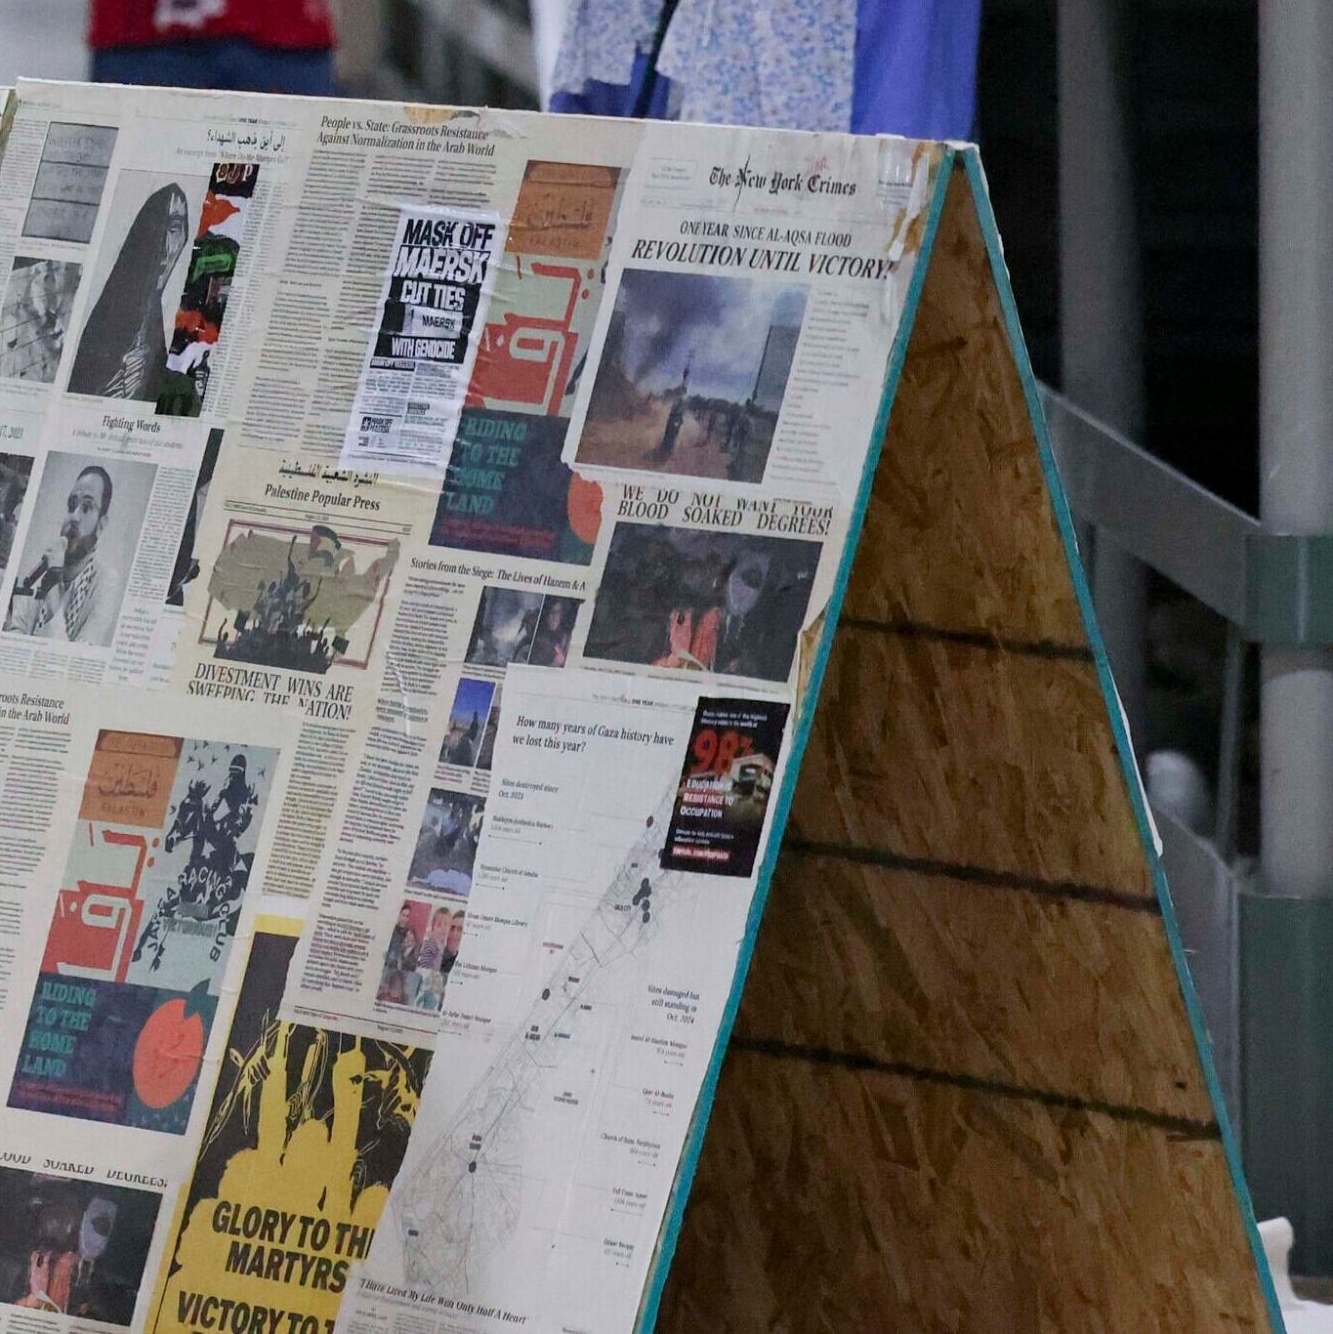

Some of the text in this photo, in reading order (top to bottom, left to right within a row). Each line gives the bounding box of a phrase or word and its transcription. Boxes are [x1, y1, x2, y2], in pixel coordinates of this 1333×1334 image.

[320, 116, 490, 140] People vs. State: Grassroots Resistance
[317, 132, 495, 157] Against Normalization in the Arab World
[709, 166, 733, 187] The
[735, 167, 766, 189] New
[769, 171, 803, 195] York
[807, 174, 857, 196] Crimes
[403, 219, 495, 249] MASK OFF
[680, 220, 852, 248] ONE YEAR SINCE AL-AQSA FLOOD
[393, 246, 491, 284] MAERSK
[632, 239, 895, 280] REVOLUTION UNTIL VICTORY!
[400, 280, 466, 311] CUT TIES
[392, 337, 455, 360] WITH GENOCIDE
[102, 415, 161, 433] Fighting Words
[265, 483, 381, 511] Palestine Popular Press
[622, 484, 644, 501] WE
[657, 489, 680, 504] DO
[691, 493, 722, 508] NOT
[617, 500, 831, 536] BLOOD SOAKED DEGREES!
[410, 557, 437, 571] Stories
[437, 560, 457, 574] from
[458, 563, 471, 576] the
[471, 566, 494, 580] Siege:
[497, 569, 512, 581] The
[512, 571, 533, 583] Lives
[534, 574, 544, 585] of
[195, 663, 354, 703] DIVESTMENT WINS ARE
[20, 693, 65, 709] Resistance
[7, 708, 21, 720] the
[23, 710, 43, 722] Arab
[44, 713, 70, 726] World
[516, 715, 674, 746] How many years of Gaza history have
[512, 734, 586, 753] we lost this year?
[680, 806, 724, 818] OCCUPATION
[683, 793, 724, 805] RESISTANCE
[212, 1200, 375, 1260] GLORY TO TH
[225, 1240, 350, 1293] MARTYRS
[178, 1291, 320, 1334] VICTORY TO
[408, 1290, 419, 1302] My
[476, 1305, 495, 1317] Half
[502, 1311, 527, 1325] Heart
